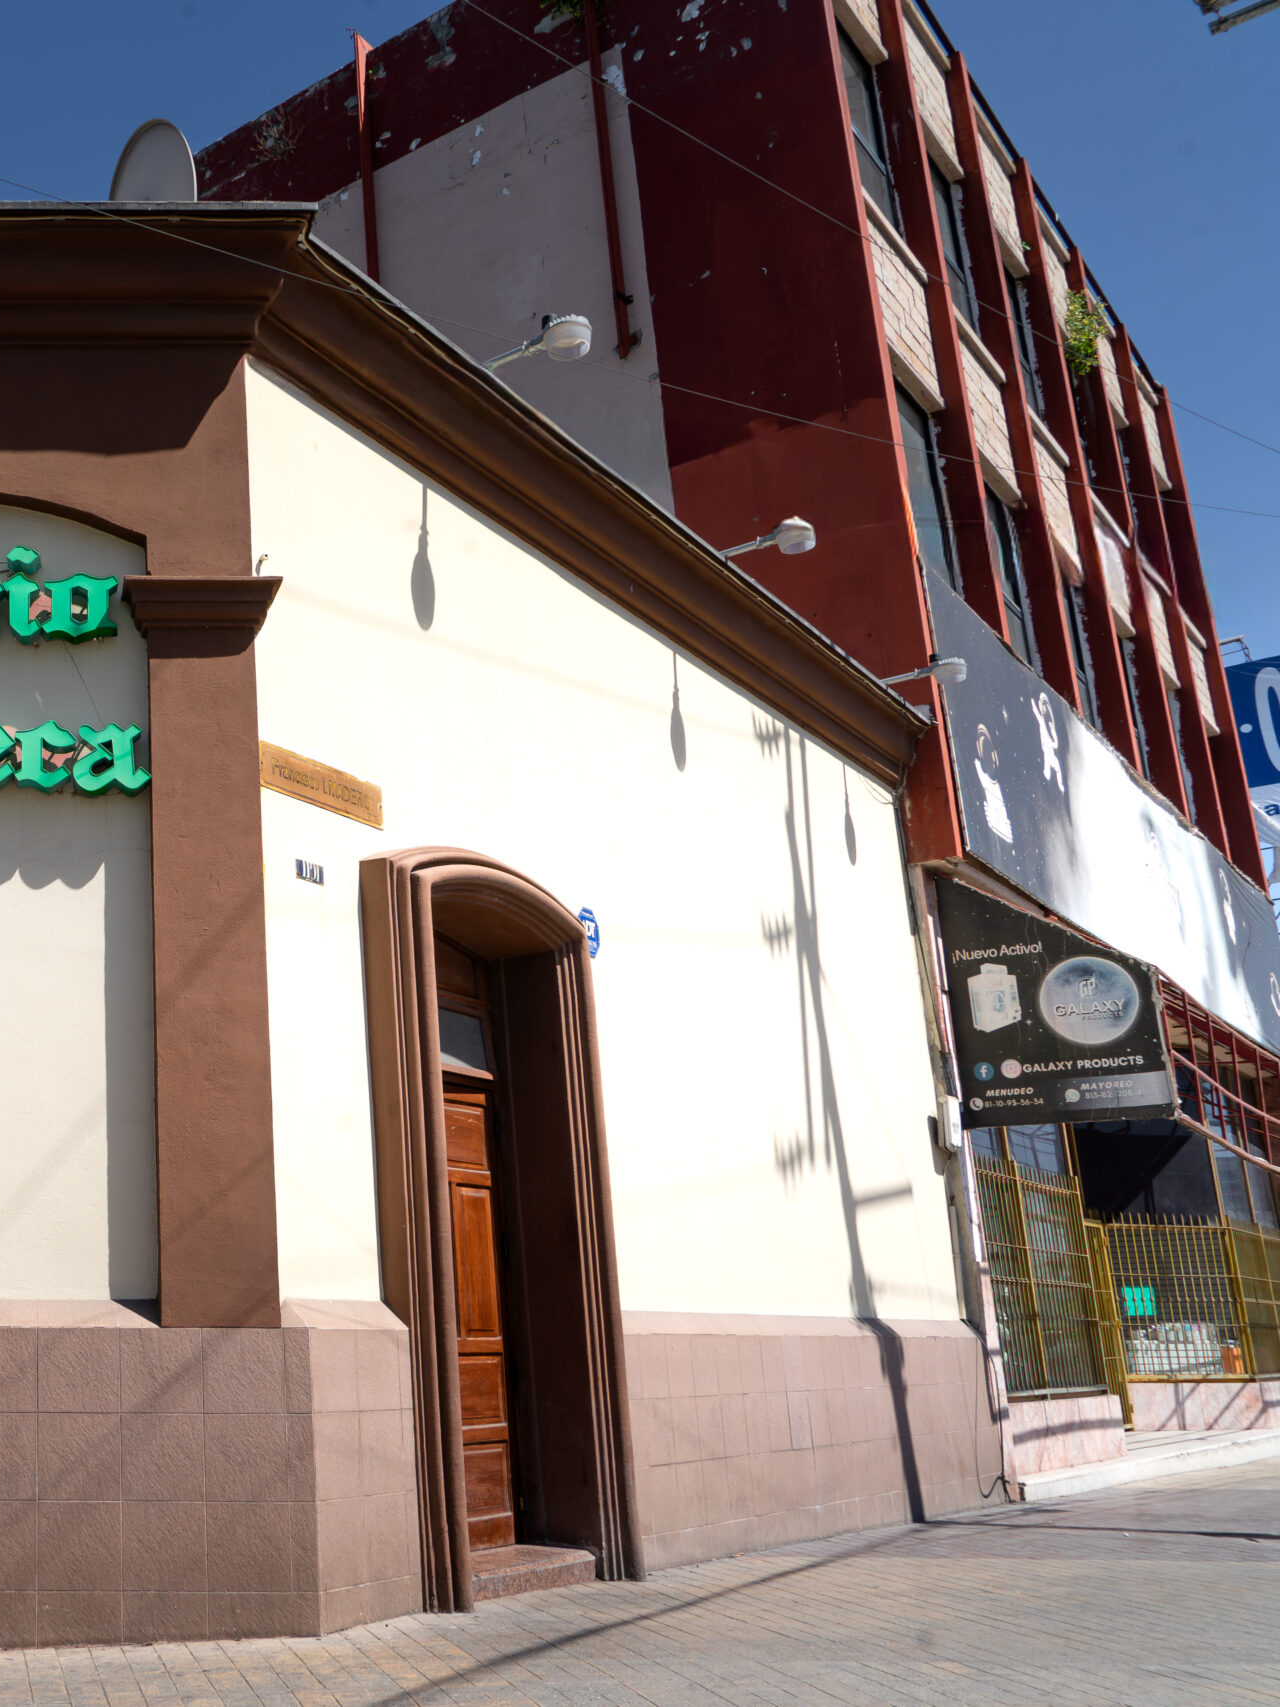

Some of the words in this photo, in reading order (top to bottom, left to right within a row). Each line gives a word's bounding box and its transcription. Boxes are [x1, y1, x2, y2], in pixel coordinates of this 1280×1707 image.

[271, 757, 320, 791] Francisco
[951, 948, 998, 965] ¡Nuevo
[999, 941, 1043, 957] Activo!
[1053, 998, 1125, 1017] GALAXY
[1022, 1060, 1073, 1073] GALAXY
[1077, 1055, 1144, 1069] PRODUCTS
[985, 1087, 1034, 1098] MENUDEO
[1080, 1080, 1133, 1091] MAYOREO
